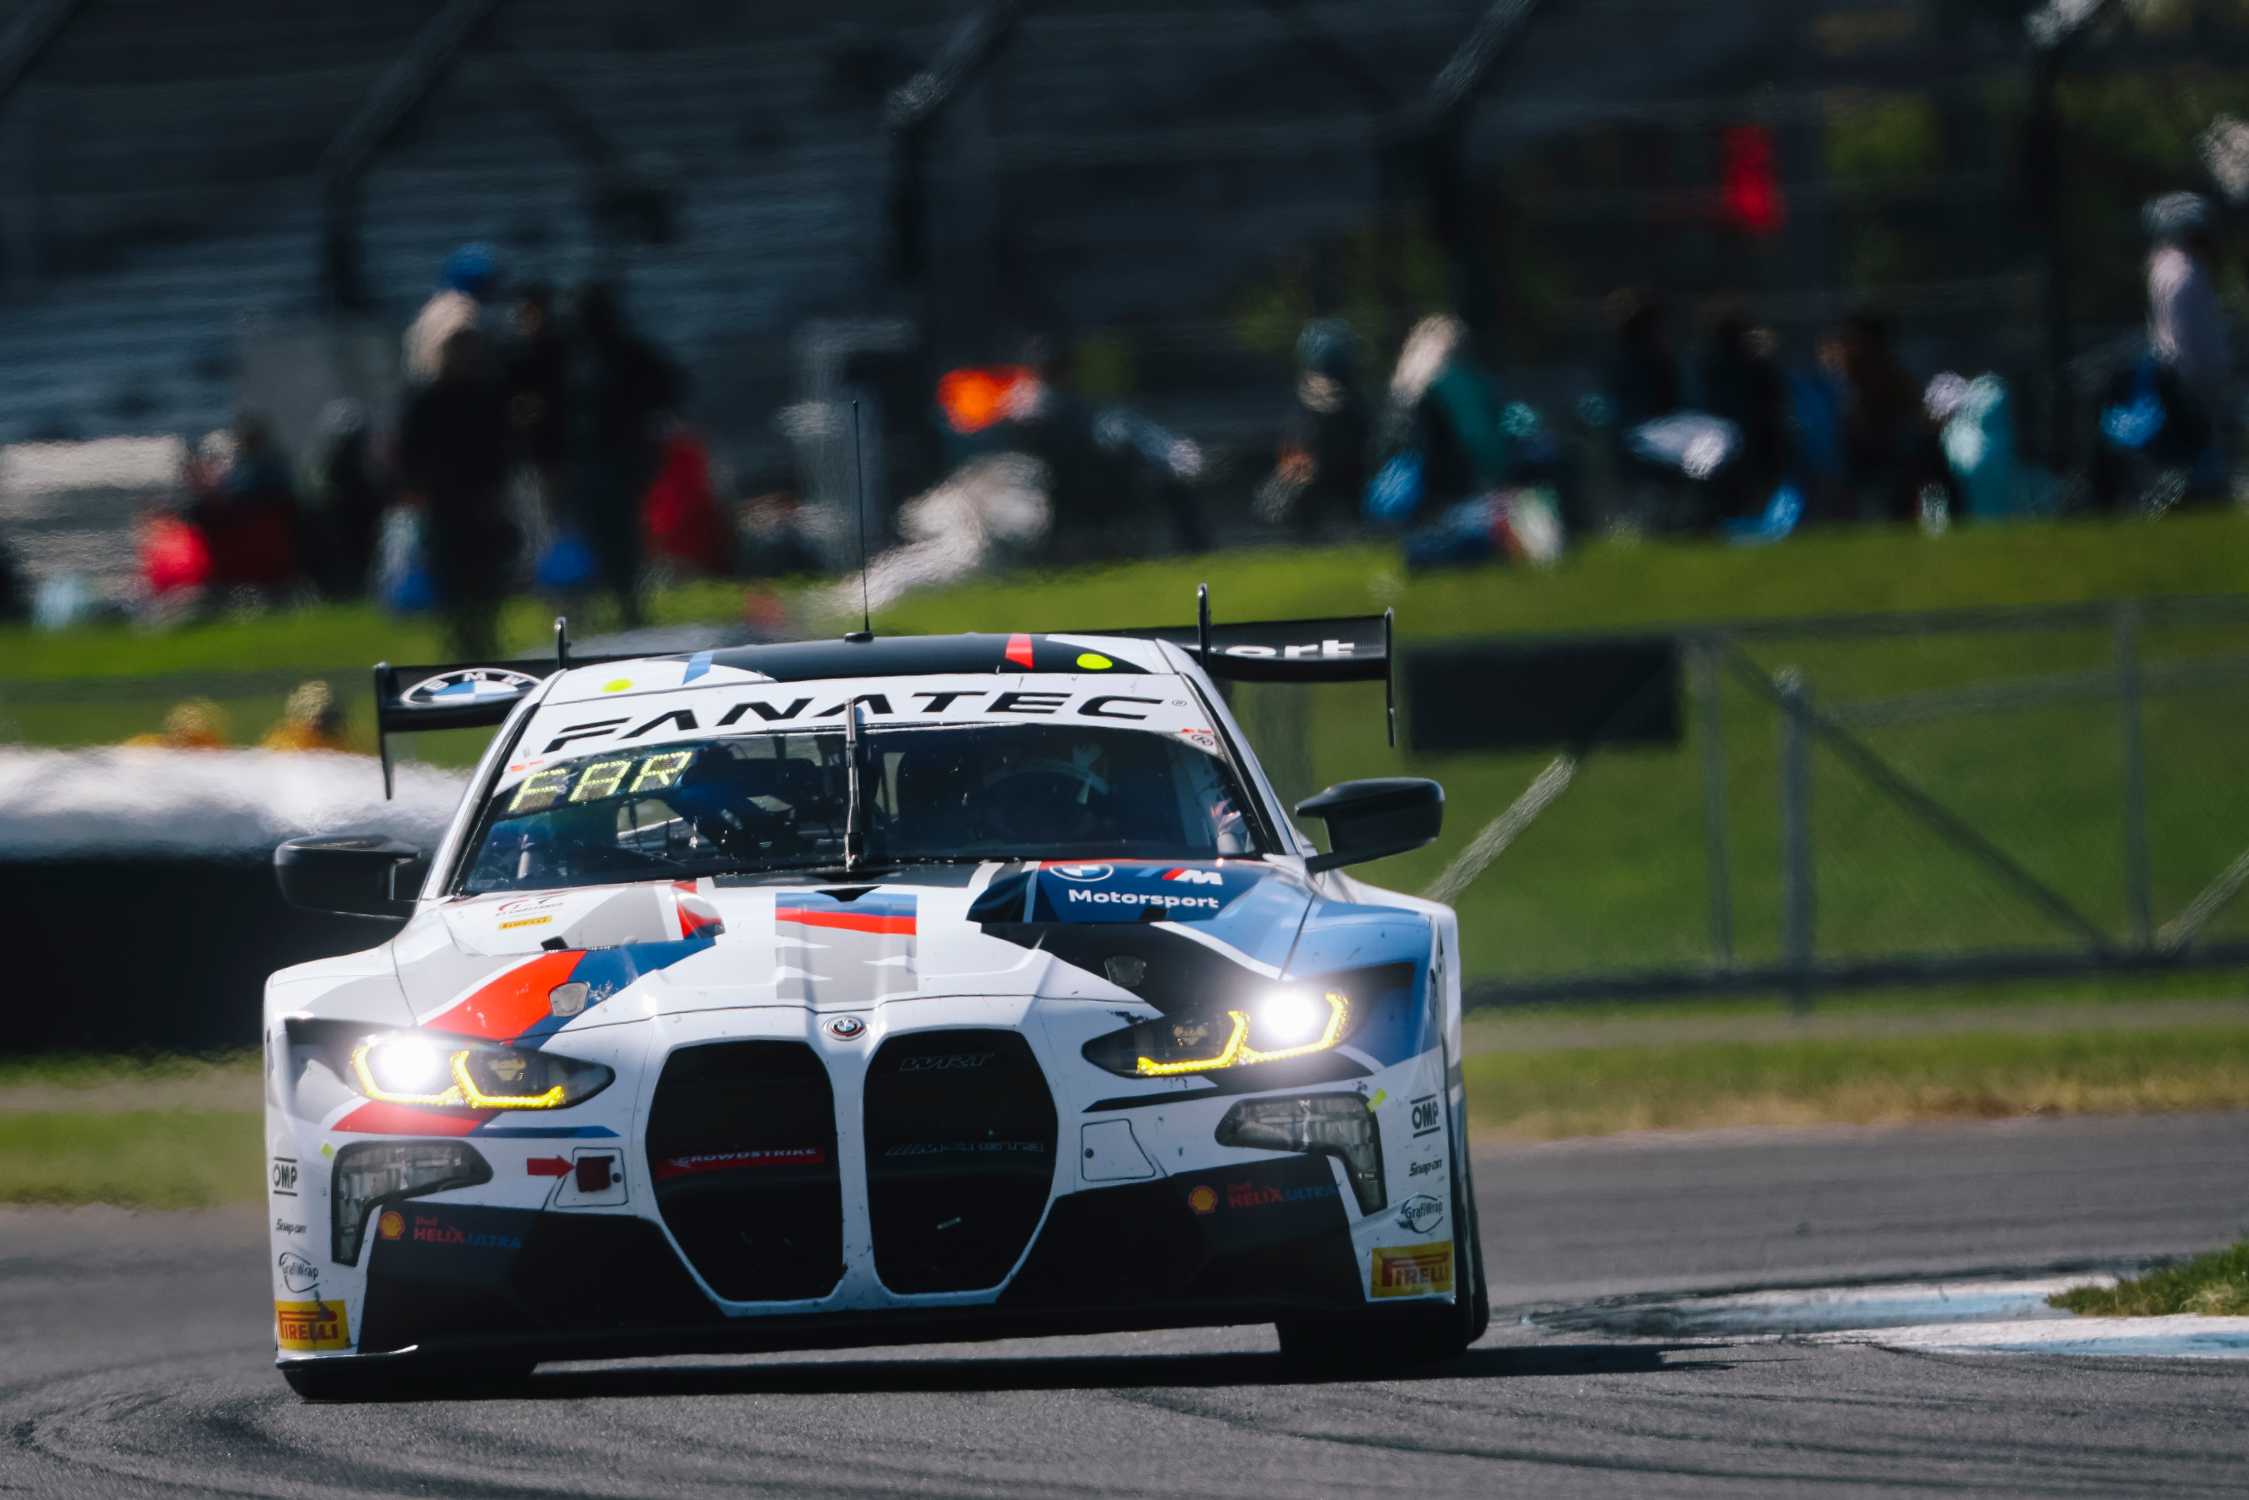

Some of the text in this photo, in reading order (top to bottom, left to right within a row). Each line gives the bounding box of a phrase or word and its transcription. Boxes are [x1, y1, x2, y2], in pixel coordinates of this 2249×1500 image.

[543, 691, 1163, 753] FANATEC
[508, 751, 693, 812] FAR
[1068, 889, 1219, 908] Motorsport
[1412, 1101, 1439, 1129] OMP
[273, 1164, 297, 1188] OMP
